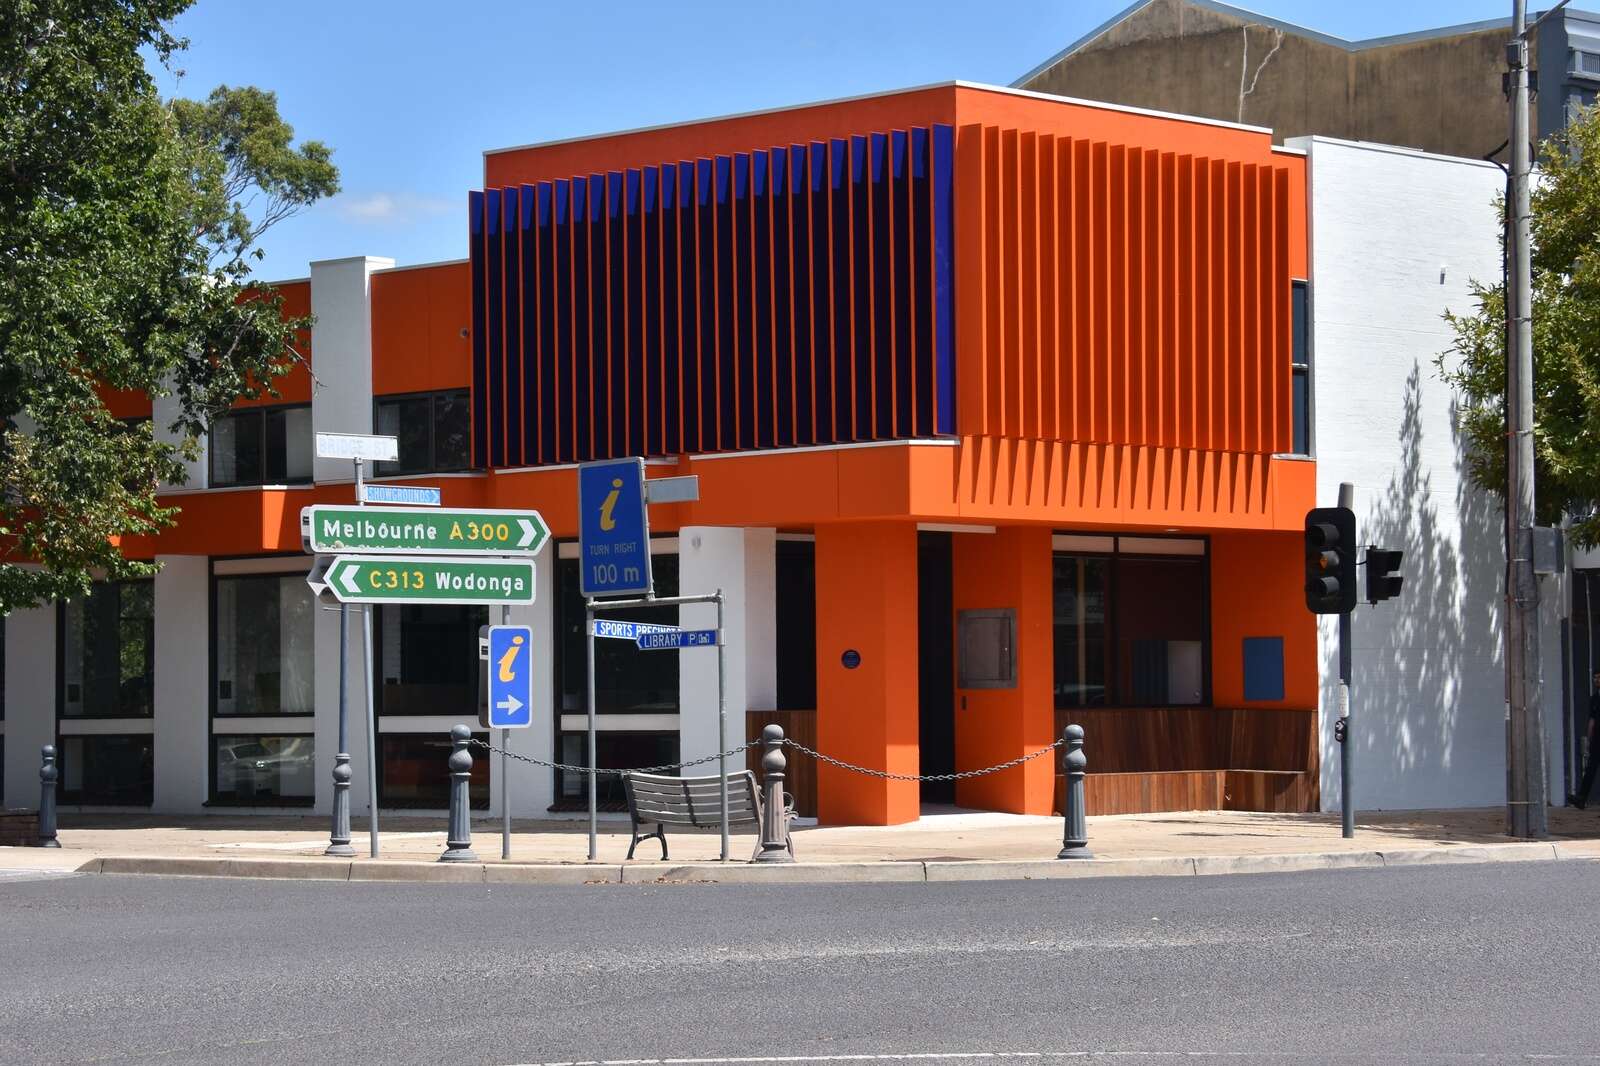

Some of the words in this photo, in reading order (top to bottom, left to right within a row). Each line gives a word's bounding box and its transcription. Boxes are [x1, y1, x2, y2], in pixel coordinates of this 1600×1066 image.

[368, 487, 430, 502] SHOWGROUNDS
[323, 520, 437, 540] Melbourne
[449, 522, 509, 542] A300
[590, 544, 610, 556] TURN
[614, 541, 637, 554] RIGHT
[593, 563, 618, 585] 100
[624, 566, 639, 583] m
[370, 570, 425, 590] C313
[436, 572, 524, 596] Wodonga
[600, 622, 632, 637] SPORTS
[636, 625, 676, 637] PREC
[644, 634, 682, 648] LIBRARY
